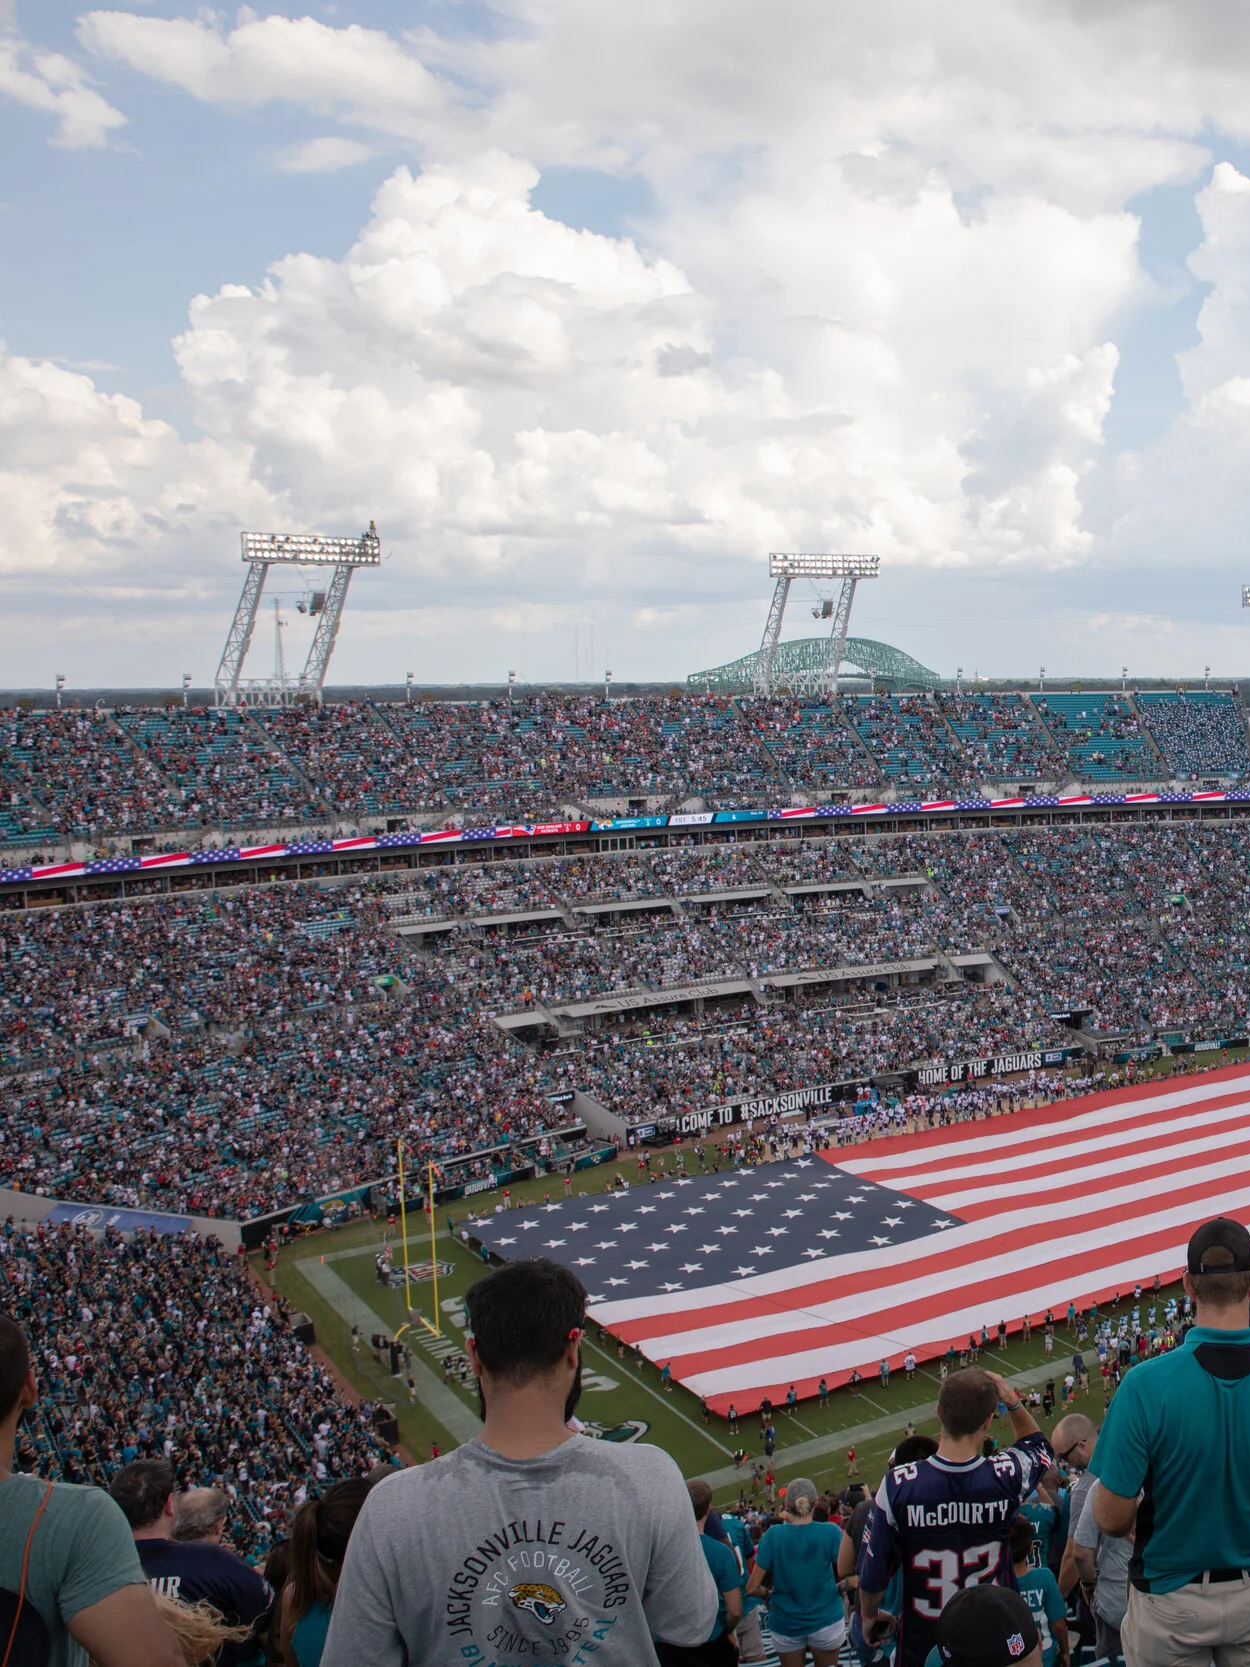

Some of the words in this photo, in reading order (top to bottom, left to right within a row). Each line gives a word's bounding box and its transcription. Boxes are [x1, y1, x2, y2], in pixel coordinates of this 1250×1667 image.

[818, 971, 837, 980] US
[883, 962, 912, 973] Club
[618, 998, 640, 1008] US
[643, 992, 688, 1004] Assure
[688, 986, 719, 998] Club
[917, 1067, 948, 1086] HOME
[950, 1065, 964, 1081] OF
[967, 1061, 988, 1078] THE
[991, 1053, 1042, 1074] JAGUARS
[718, 1107, 733, 1125] TO
[740, 1087, 832, 1119] #SACKSONVILLE
[907, 1499, 1010, 1528] McCOURTY
[446, 1519, 566, 1637] JACKSONVILLE
[567, 1528, 630, 1610] JAGUARS
[481, 1570, 509, 1607] AFC
[507, 1550, 595, 1597] FOOTBALL
[486, 1624, 542, 1657] SINCE
[549, 1616, 590, 1656] 1995
[571, 1614, 618, 1666] TEAL
